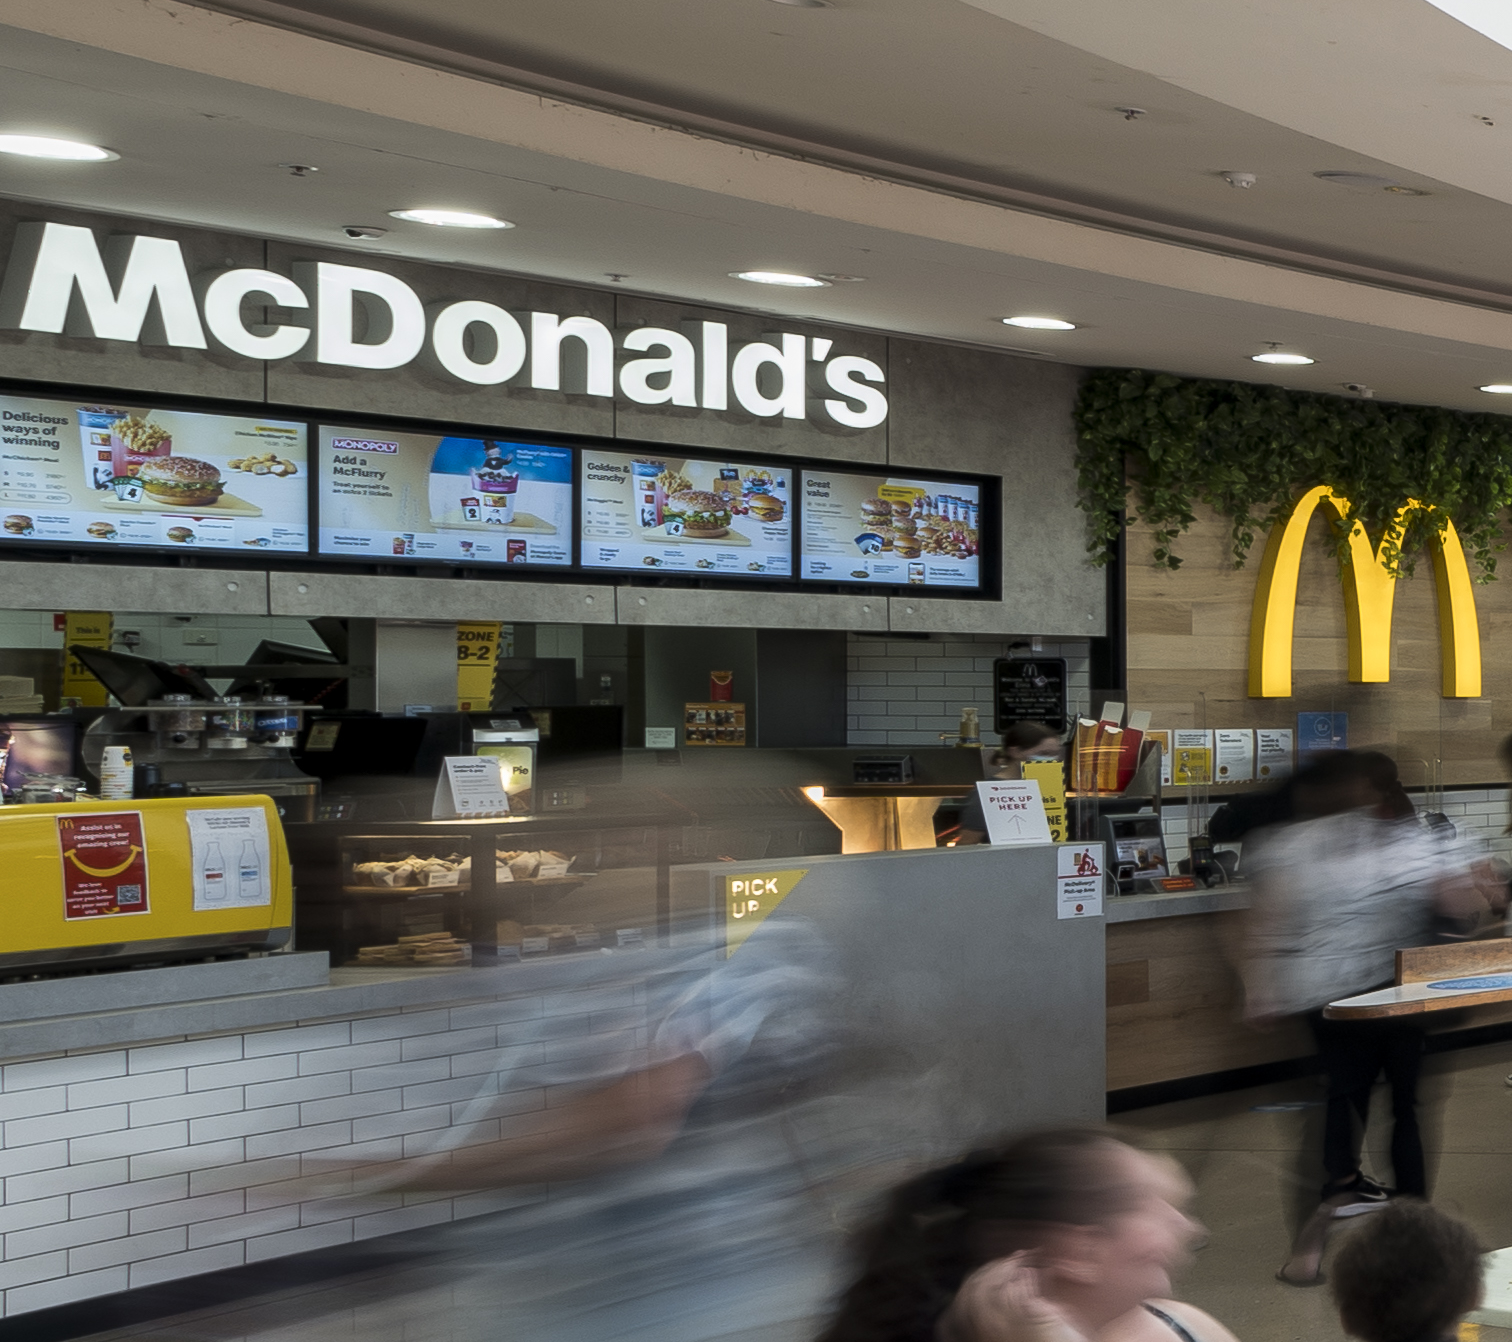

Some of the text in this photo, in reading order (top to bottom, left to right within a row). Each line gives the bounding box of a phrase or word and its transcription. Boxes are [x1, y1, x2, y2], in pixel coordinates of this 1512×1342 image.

[20, 222, 888, 429] McDonald's
[2, 411, 69, 425] Delicious
[1, 425, 57, 436] ways of
[1, 435, 60, 450] winning
[333, 439, 397, 452] MONOPOLY
[333, 455, 367, 466] Add a
[333, 466, 387, 481] McFlurry
[587, 462, 630, 474] Golden &
[587, 473, 627, 485] crunchy
[806, 479, 831, 489] Great
[806, 488, 830, 499] value
[457, 630, 495, 642] ZONE
[512, 765, 529, 775] Pie
[988, 794, 1033, 804] PICK UP
[998, 803, 1028, 811] HERE
[731, 877, 779, 897] PICK
[732, 899, 760, 919] UP
